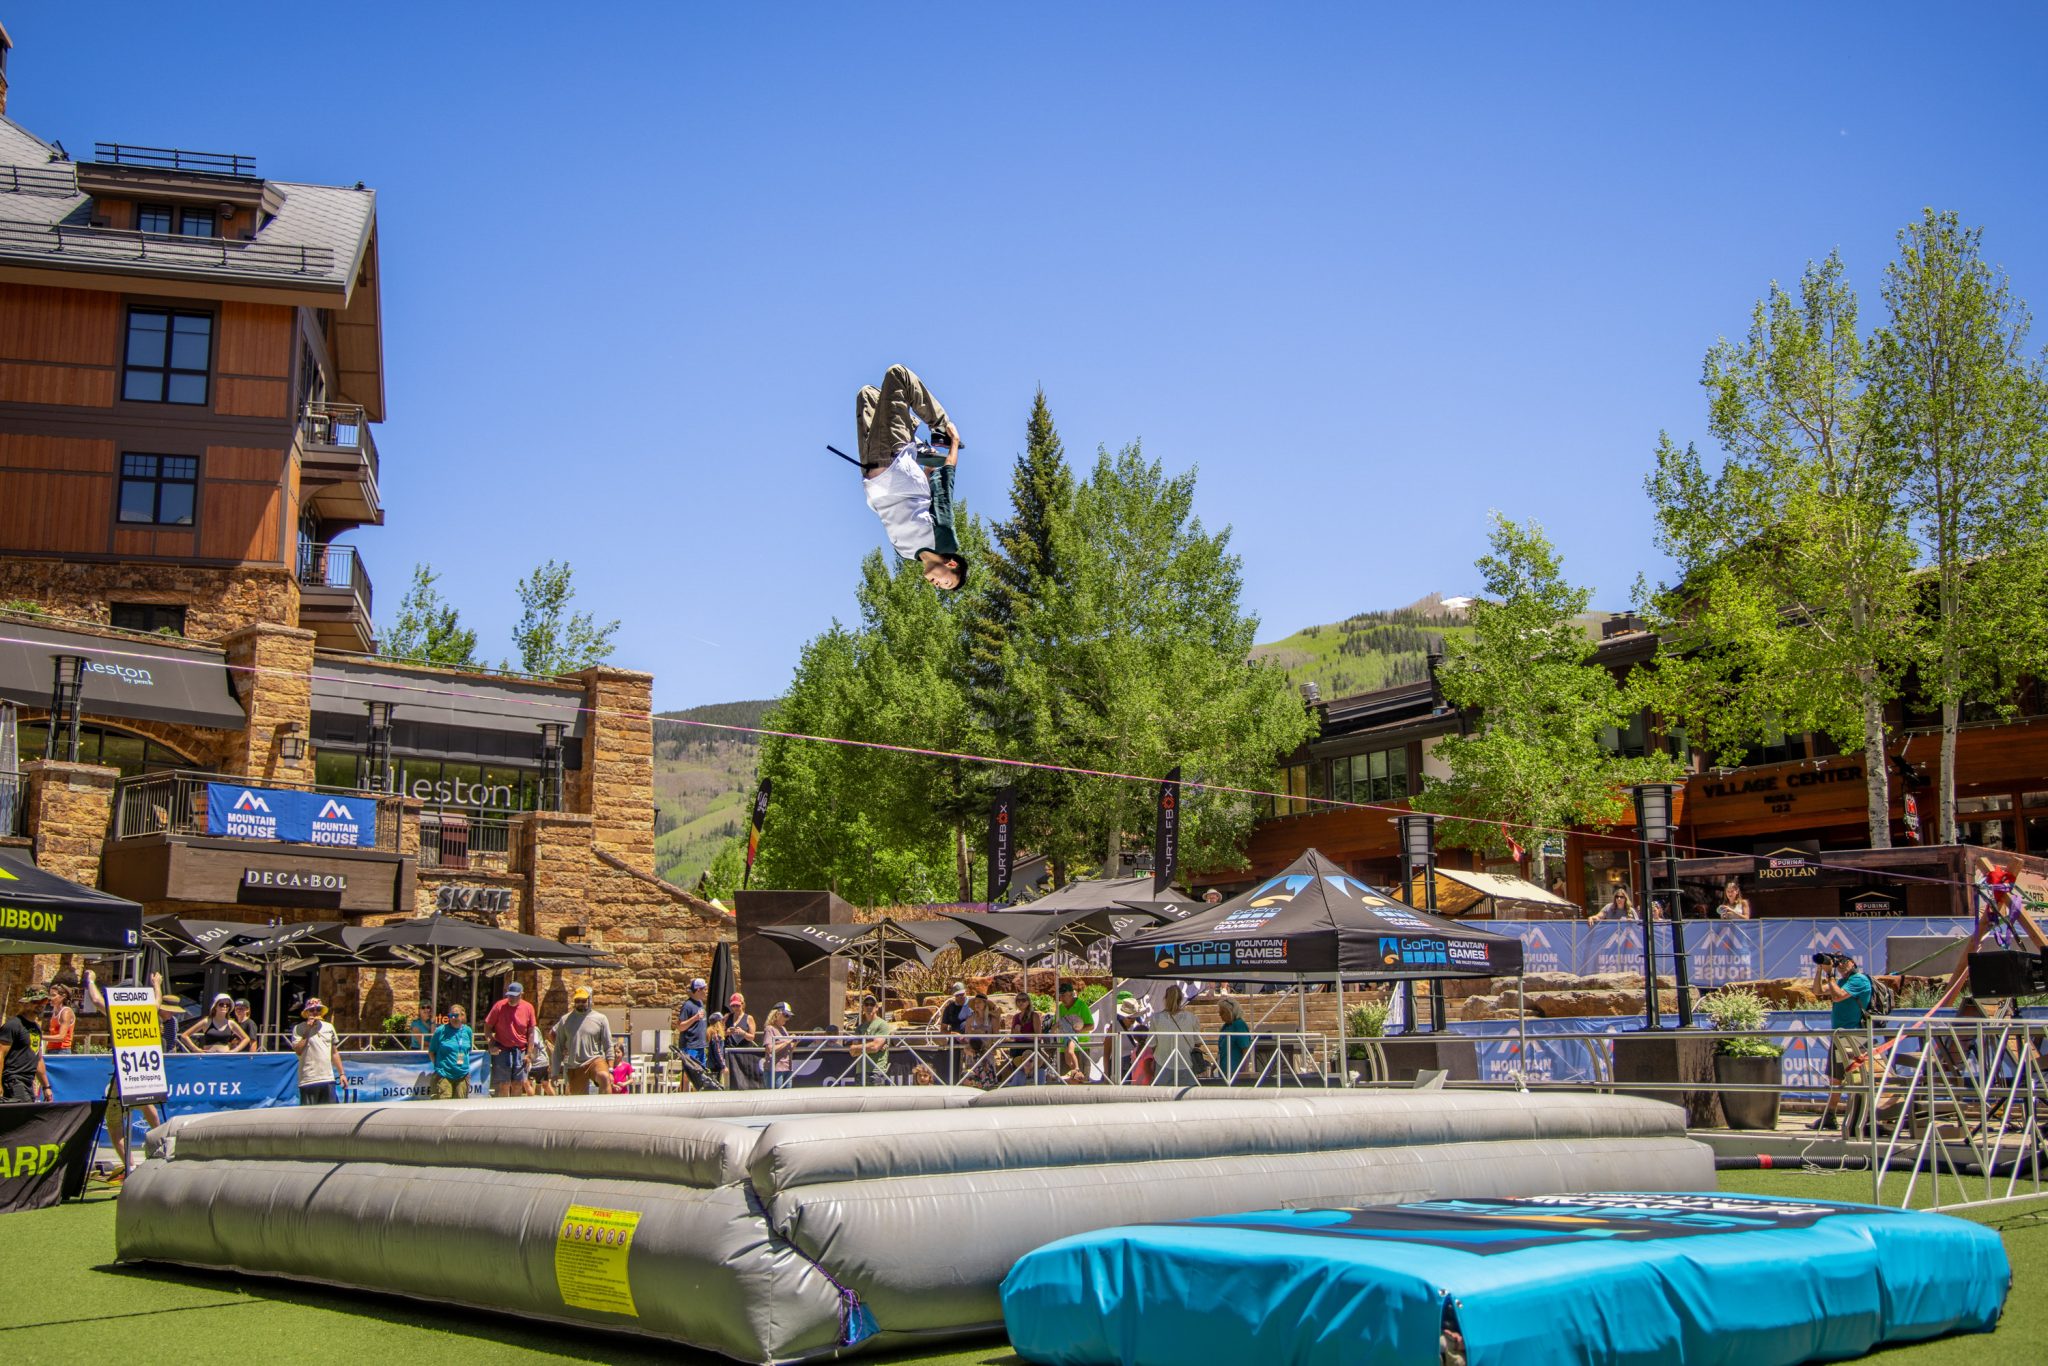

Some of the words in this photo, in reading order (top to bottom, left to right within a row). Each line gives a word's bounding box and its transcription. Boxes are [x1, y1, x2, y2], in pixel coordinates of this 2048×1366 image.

[1703, 776, 1778, 798] VILLAGE
[1786, 766, 1863, 788] CENTER
[1772, 804, 1791, 813] 122
[227, 812, 277, 827] MOUNTAIN
[227, 823, 277, 839] HOUSE
[312, 821, 358, 834] MOUNTAIN
[311, 832, 359, 846] HOUSE
[997, 804, 1009, 886] TURTLEBOX
[1759, 869, 1784, 879] PRO
[1785, 867, 1817, 877] PLAN
[436, 885, 513, 912] SKATE
[1179, 942, 1231, 954] GoPro
[1401, 939, 1445, 950] GoPro
[1447, 940, 1485, 950] MOUNTAIN
[1235, 948, 1283, 958] GAMES
[1449, 948, 1486, 960] GAMES
[116, 1011, 151, 1025] SHOW
[116, 1028, 157, 1040] SPECIAL!
[121, 1050, 160, 1075] $149
